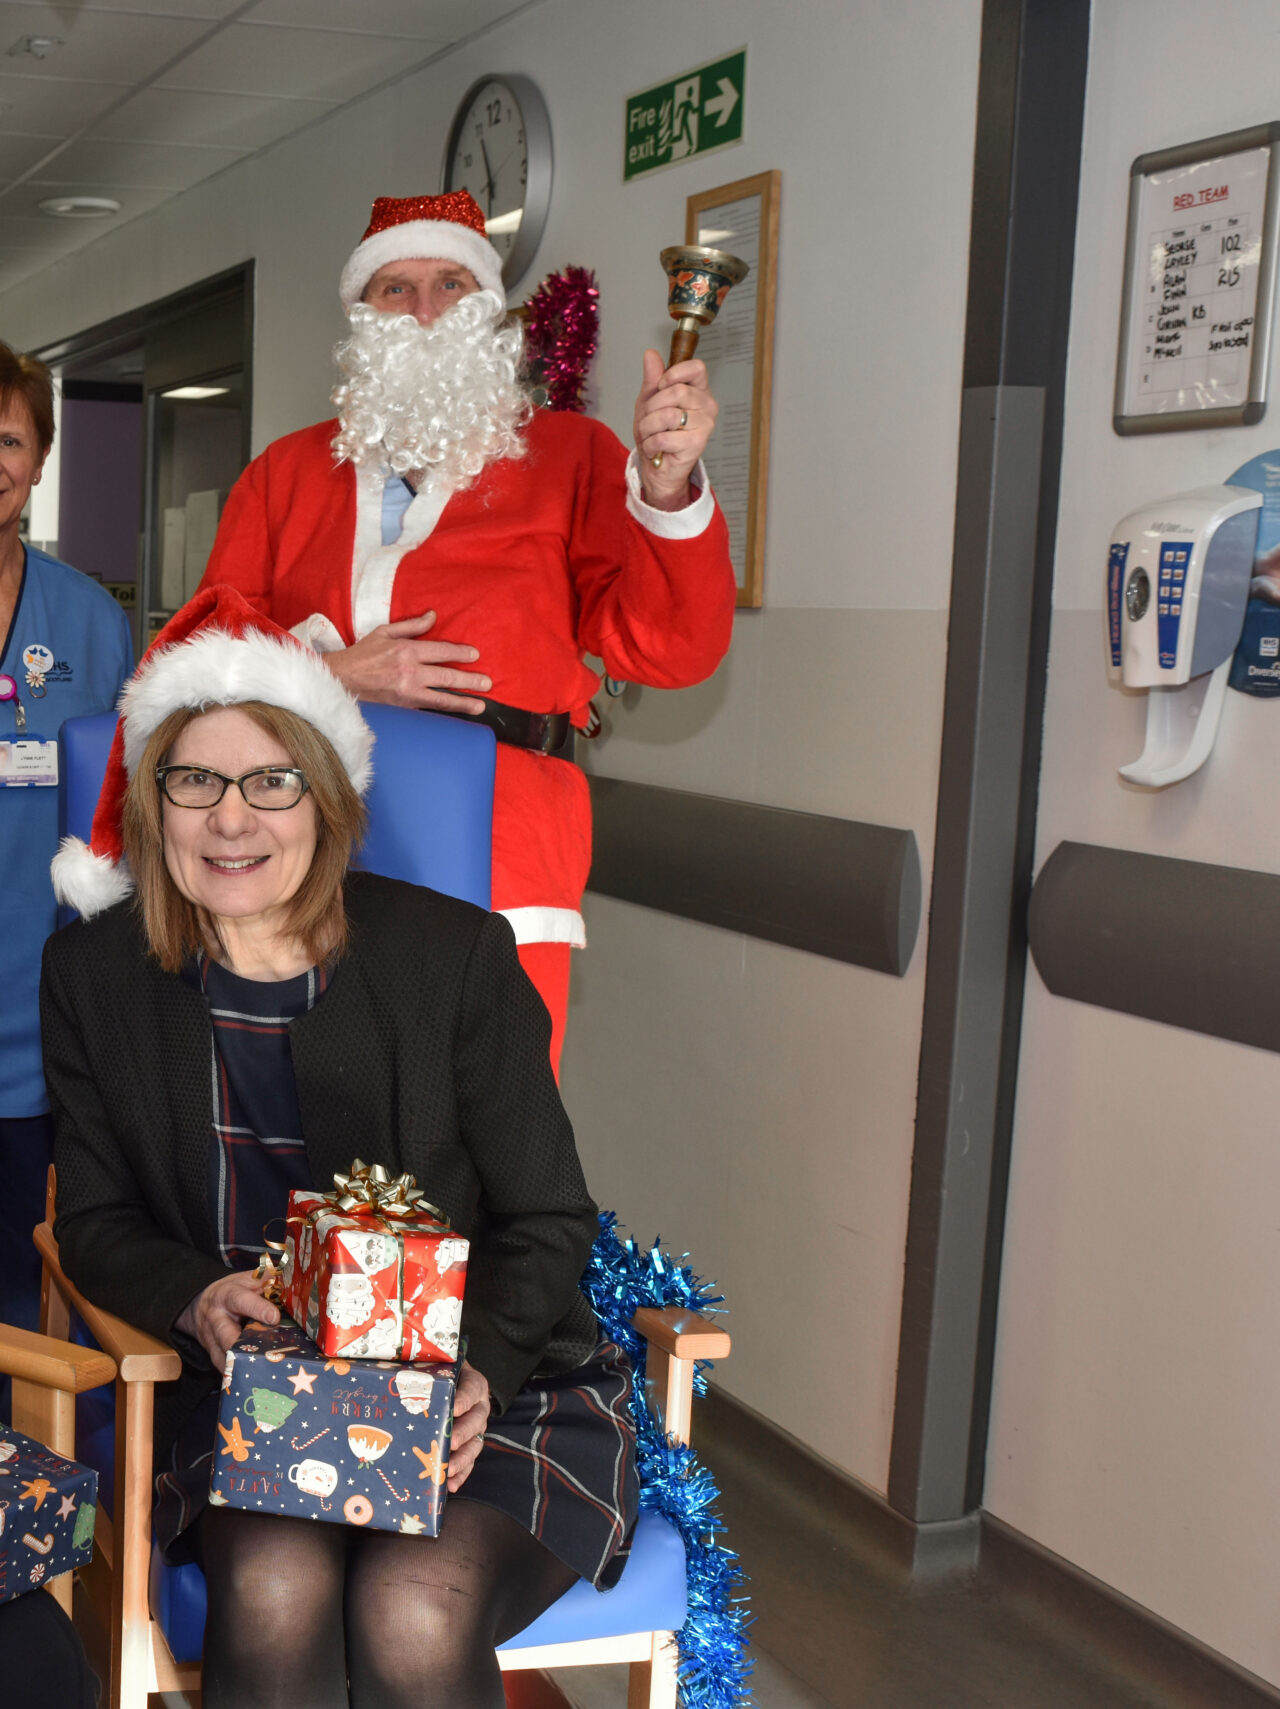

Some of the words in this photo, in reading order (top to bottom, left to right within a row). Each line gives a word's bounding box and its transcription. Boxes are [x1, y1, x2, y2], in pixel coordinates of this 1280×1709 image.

[486, 98, 501, 127] 12
[629, 107, 657, 133] Fire
[628, 134, 656, 164] exit
[520, 159, 527, 184] 3
[1173, 193, 1194, 208] RED
[1198, 184, 1229, 202] TEAM
[1221, 234, 1241, 255] 102
[1218, 266, 1240, 287] 215
[110, 587, 135, 602] Toi
[331, 1400, 388, 1420] MERRY
[229, 1476, 281, 1496] SANTA
